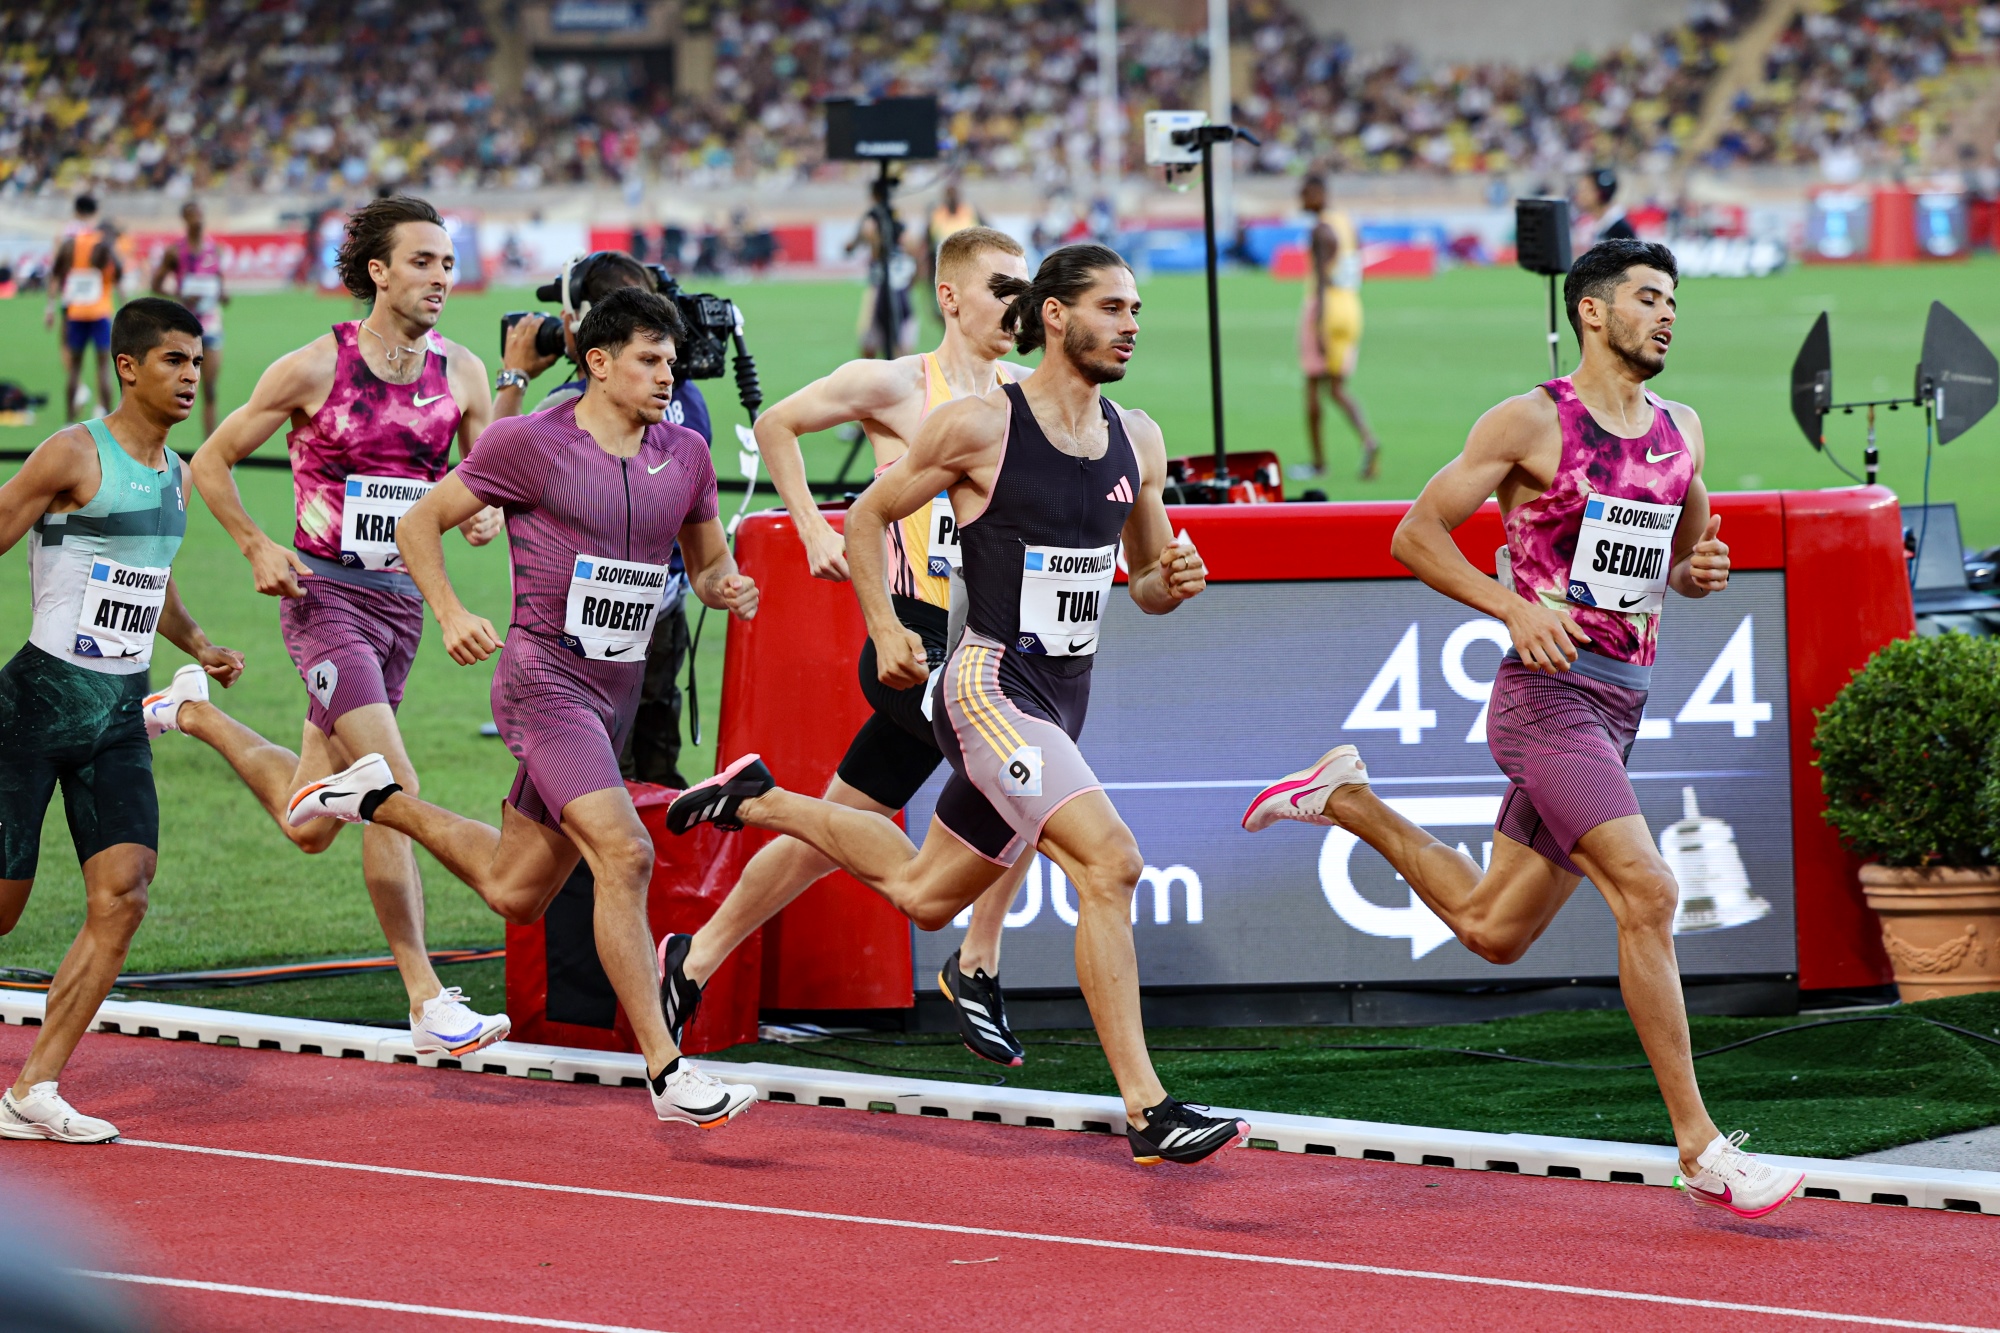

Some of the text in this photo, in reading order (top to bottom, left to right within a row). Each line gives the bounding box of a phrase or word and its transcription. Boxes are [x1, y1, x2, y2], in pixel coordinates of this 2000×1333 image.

[130, 481, 151, 494] OAC
[366, 483, 431, 501] SLOVENIJA
[355, 513, 402, 543] KRA
[1592, 539, 1665, 580] SEDJATI
[595, 565, 664, 588] SLOVENIJALE
[581, 595, 655, 632] ROBERT
[1056, 589, 1100, 623] TUAL
[316, 670, 329, 691] 4
[1009, 760, 1031, 786] 9
